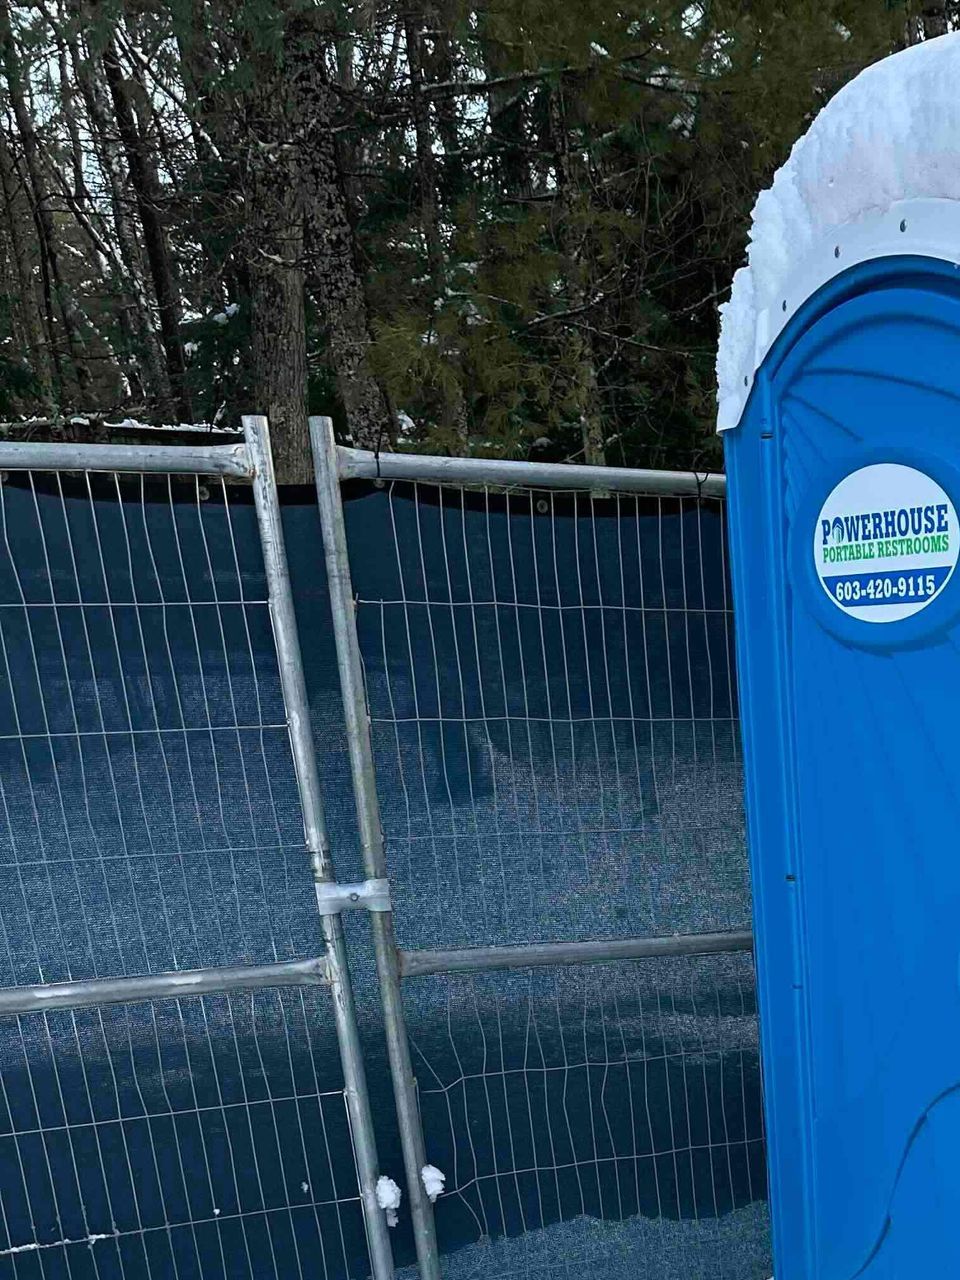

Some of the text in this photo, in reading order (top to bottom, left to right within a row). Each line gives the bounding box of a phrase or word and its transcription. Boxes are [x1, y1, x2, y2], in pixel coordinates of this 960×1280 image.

[821, 504, 949, 545] POWERHOUSE
[823, 534, 949, 563] PORTABLE RESTROOMS
[836, 575, 936, 600] 603-420-9115
